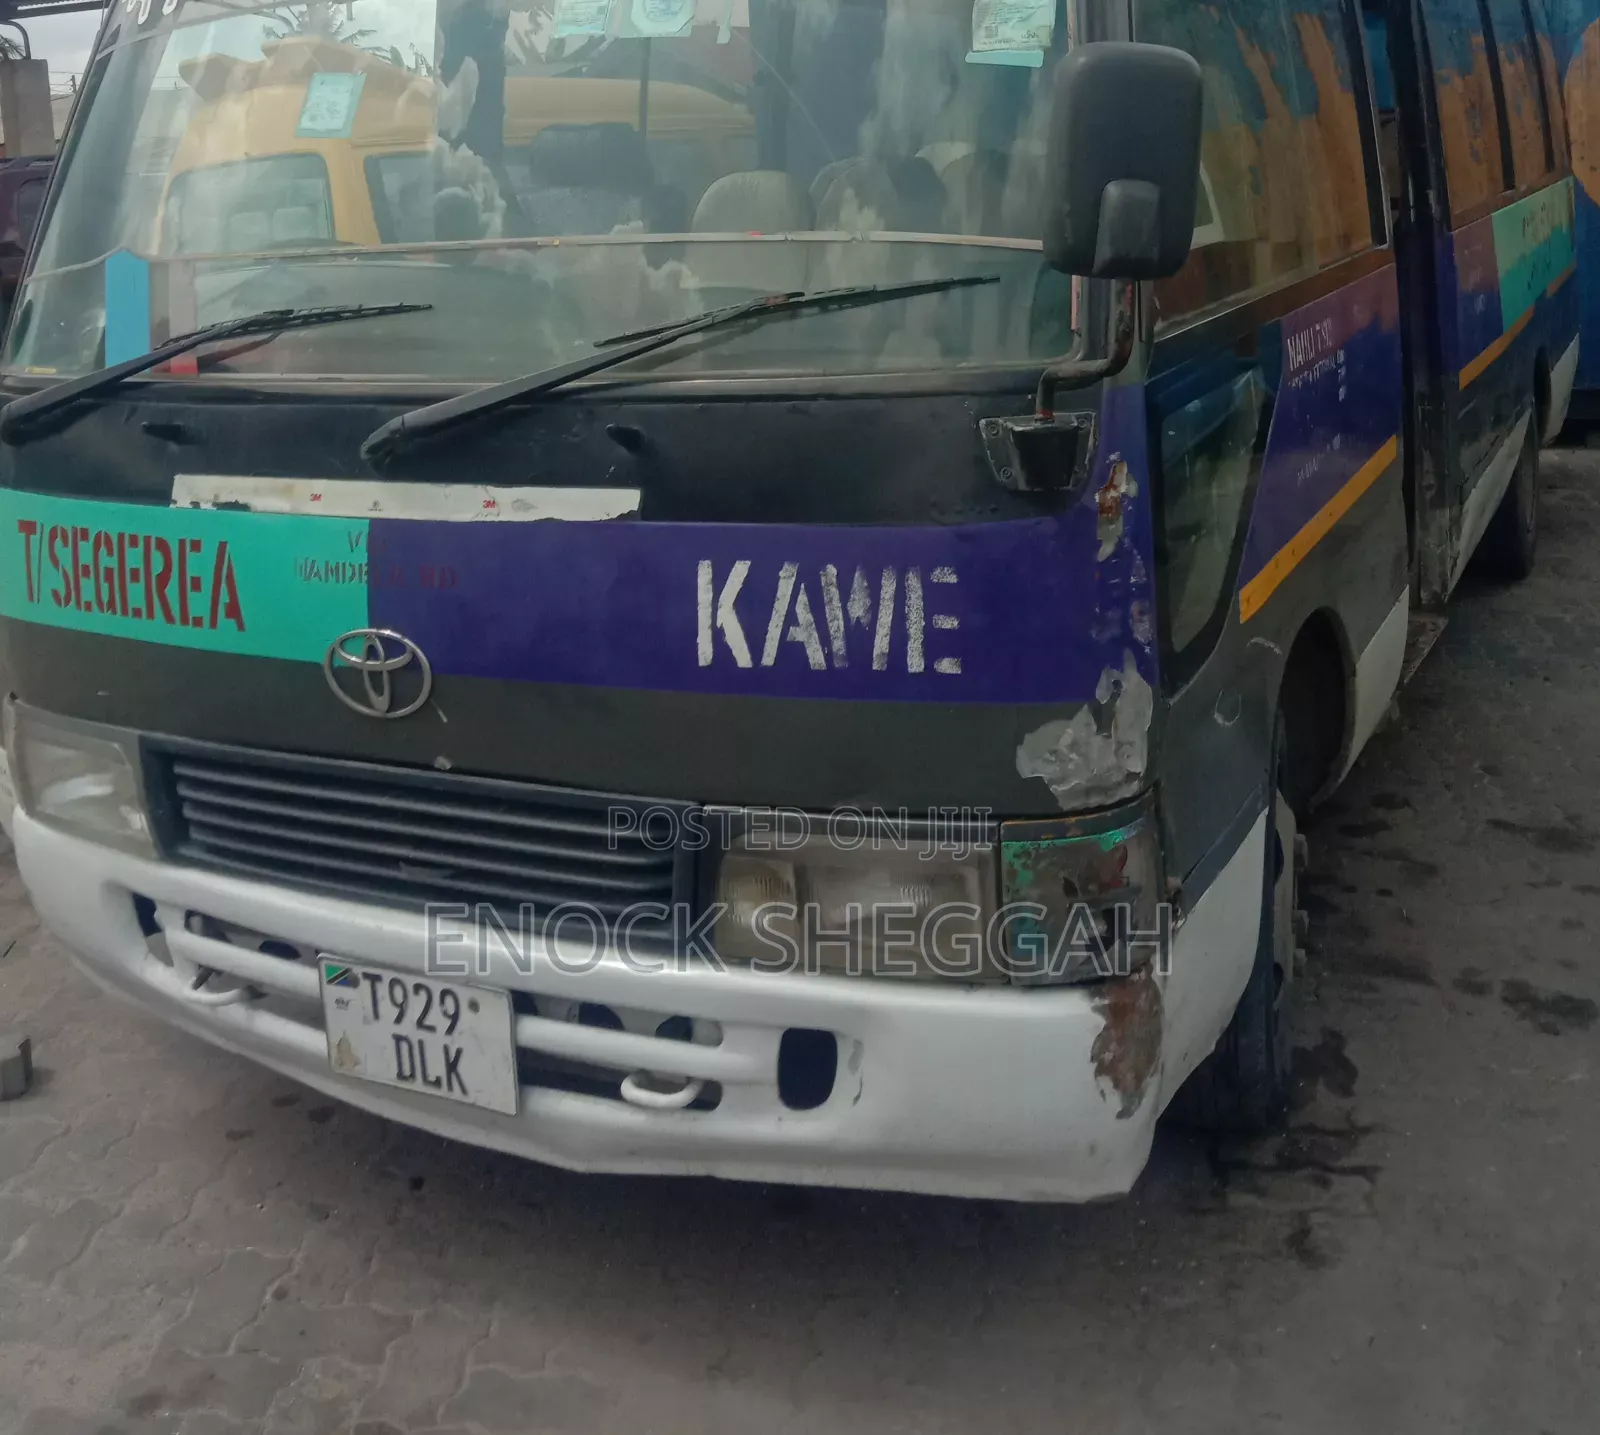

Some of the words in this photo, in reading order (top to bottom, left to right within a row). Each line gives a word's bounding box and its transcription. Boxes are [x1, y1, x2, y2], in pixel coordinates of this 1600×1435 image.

[310, 493, 322, 502] 3M
[482, 499, 496, 509] 3M
[17, 519, 246, 632] T/SEGEREA
[697, 559, 962, 675] KAWE
[361, 971, 461, 1036] T929
[392, 1033, 469, 1096] DLK
